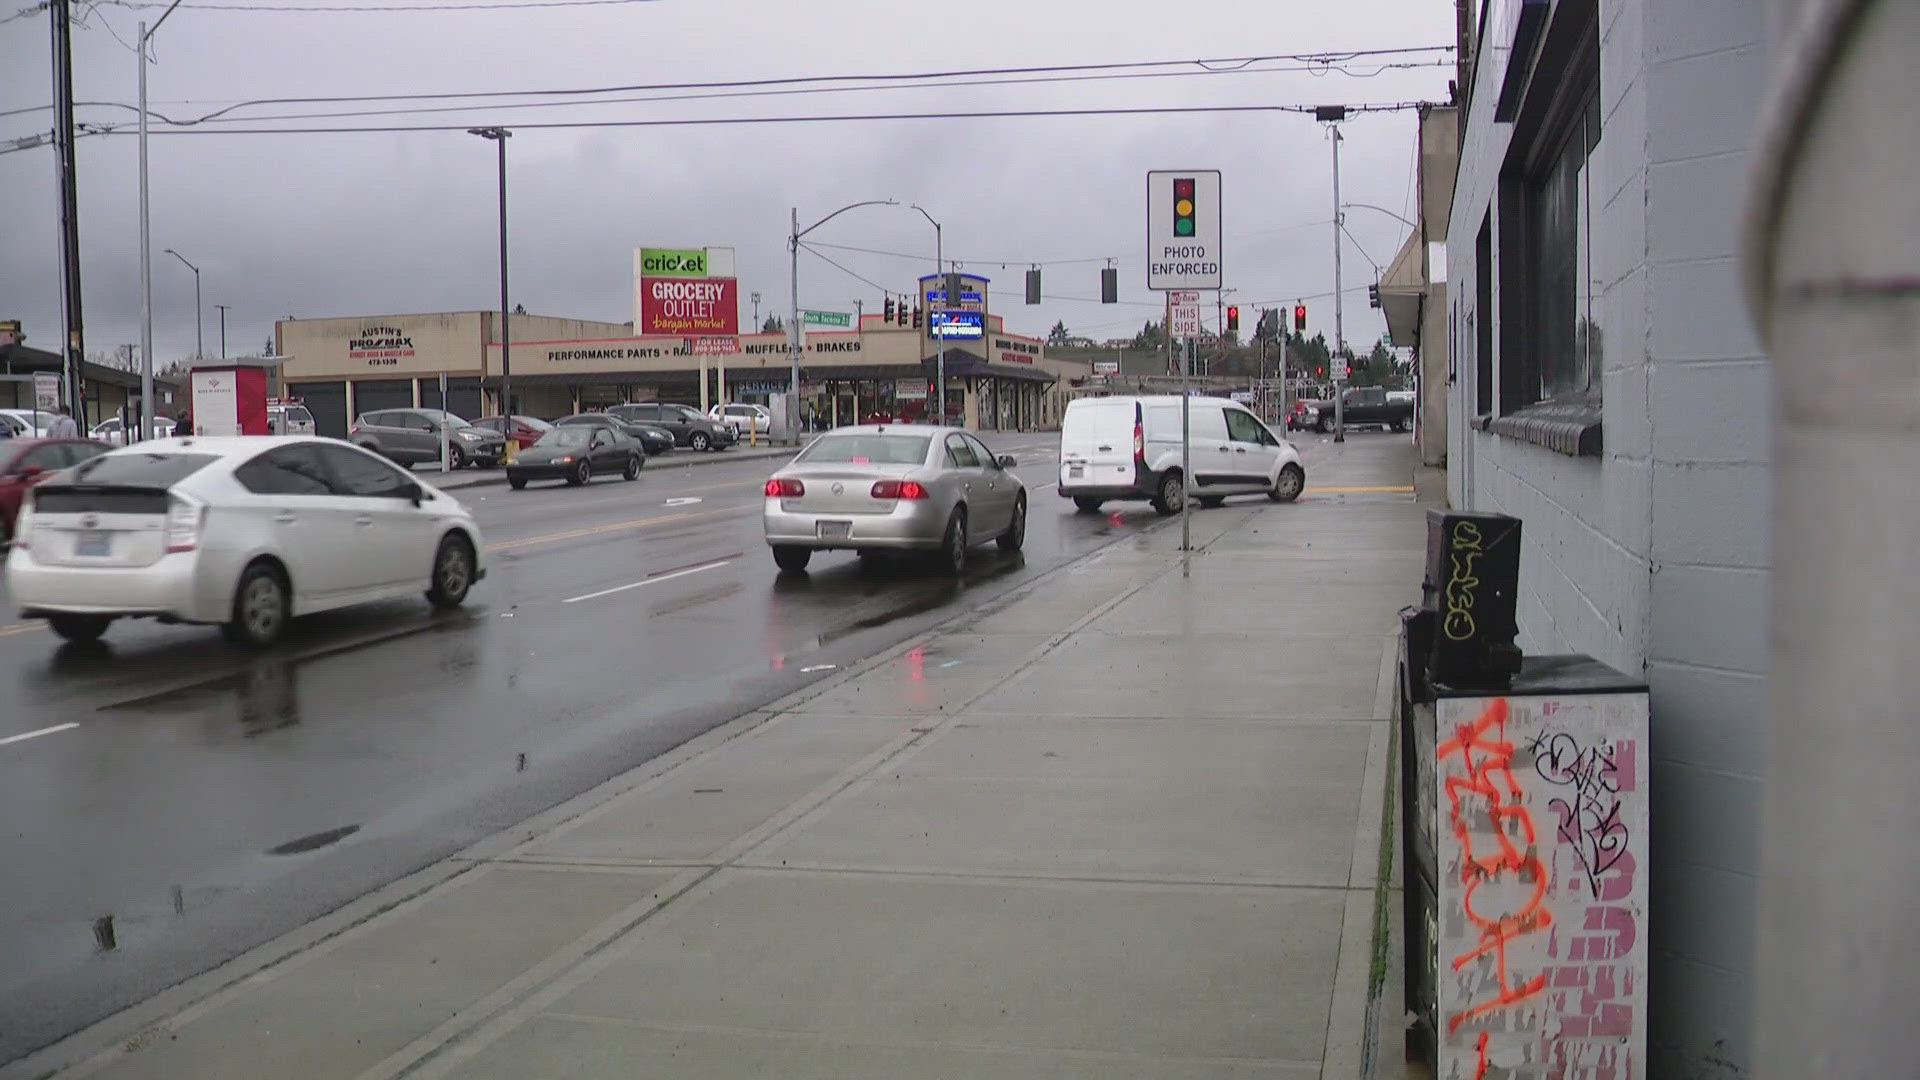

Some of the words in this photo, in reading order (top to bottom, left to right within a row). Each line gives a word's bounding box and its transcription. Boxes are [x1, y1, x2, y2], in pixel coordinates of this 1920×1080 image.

[1164, 246, 1205, 258] PHOTO
[644, 254, 704, 272] cricket
[1152, 263, 1218, 275] ENFORCED
[652, 281, 725, 301] GROCERY
[663, 299, 716, 318] OUTLET
[1175, 308, 1196, 319] THIS
[653, 313, 693, 334] bargain
[694, 317, 726, 329] market
[1174, 321, 1196, 333] SIDE
[361, 326, 402, 338] AUSTIN'S
[816, 341, 861, 353] BRAKES
[548, 349, 624, 361] PERFORMANCE
[627, 347, 660, 358] PARTS
[738, 381, 785, 391] SERVICE
